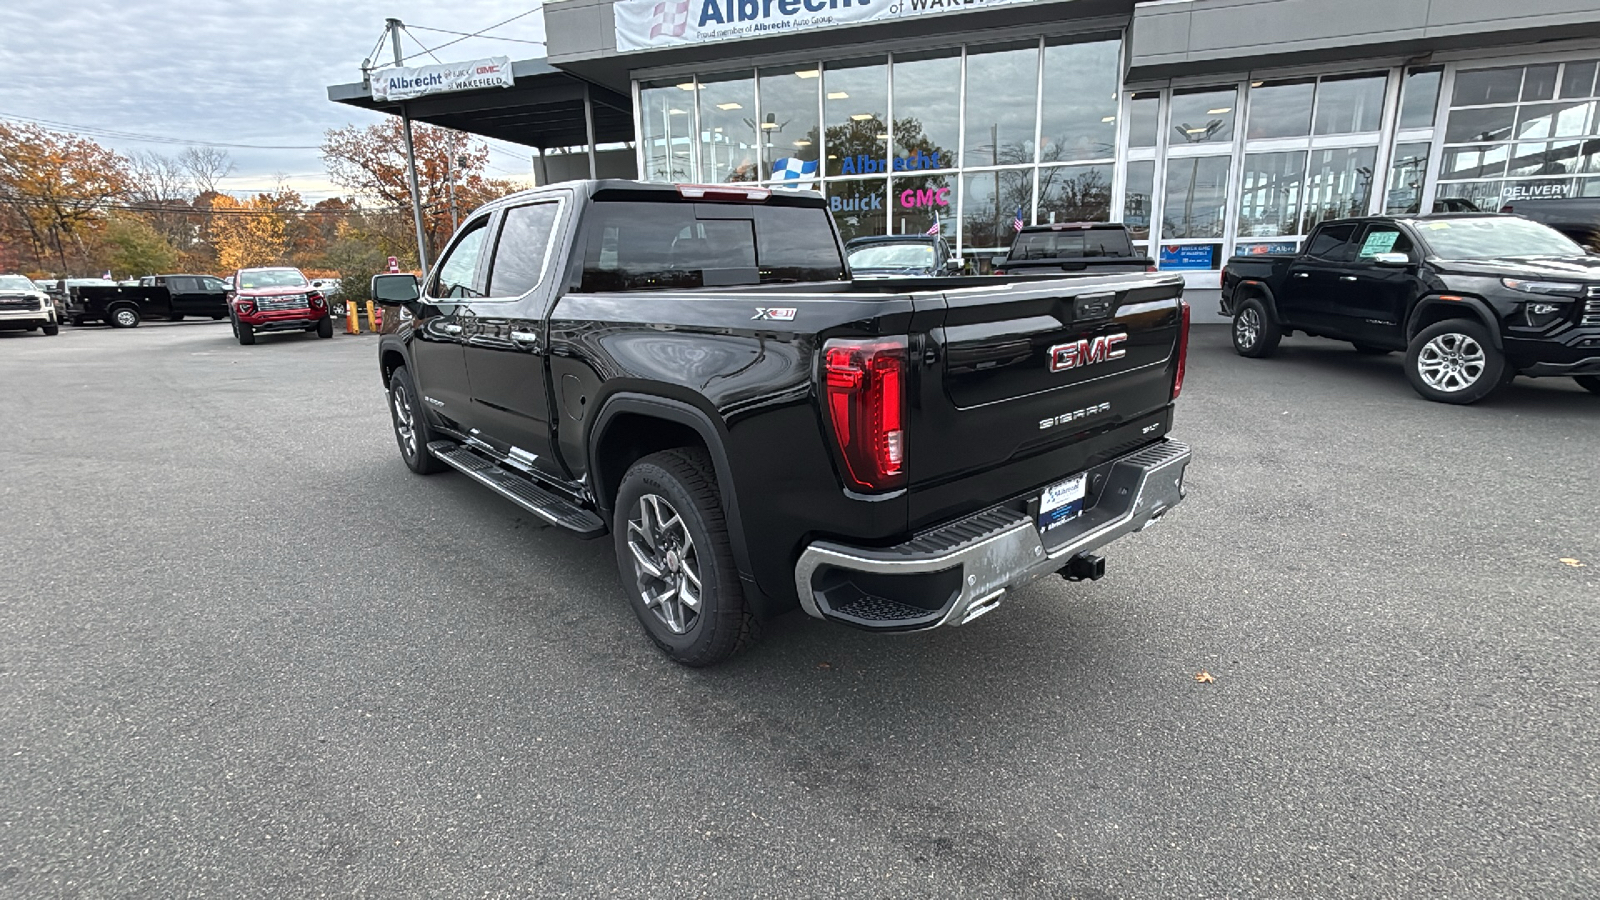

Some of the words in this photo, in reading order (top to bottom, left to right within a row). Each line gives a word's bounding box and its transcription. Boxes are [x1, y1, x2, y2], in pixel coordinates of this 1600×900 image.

[698, 0, 872, 27] Albrec
[697, 30, 715, 39] Proud
[717, 27, 744, 37] member
[745, 25, 753, 33] of
[753, 21, 790, 32] Albrecht
[793, 18, 810, 27] Auto
[811, 15, 833, 25] Group
[390, 73, 442, 89] Albrecht
[476, 65, 500, 75] GMC
[455, 77, 502, 89] WAKEFIELD
[842, 150, 941, 174] Albrecht
[831, 193, 882, 212] Buick
[901, 187, 950, 208] GMC
[1503, 184, 1570, 196] DELIVERY
[1047, 332, 1128, 373] GMC
[1039, 402, 1110, 430] SIERRA
